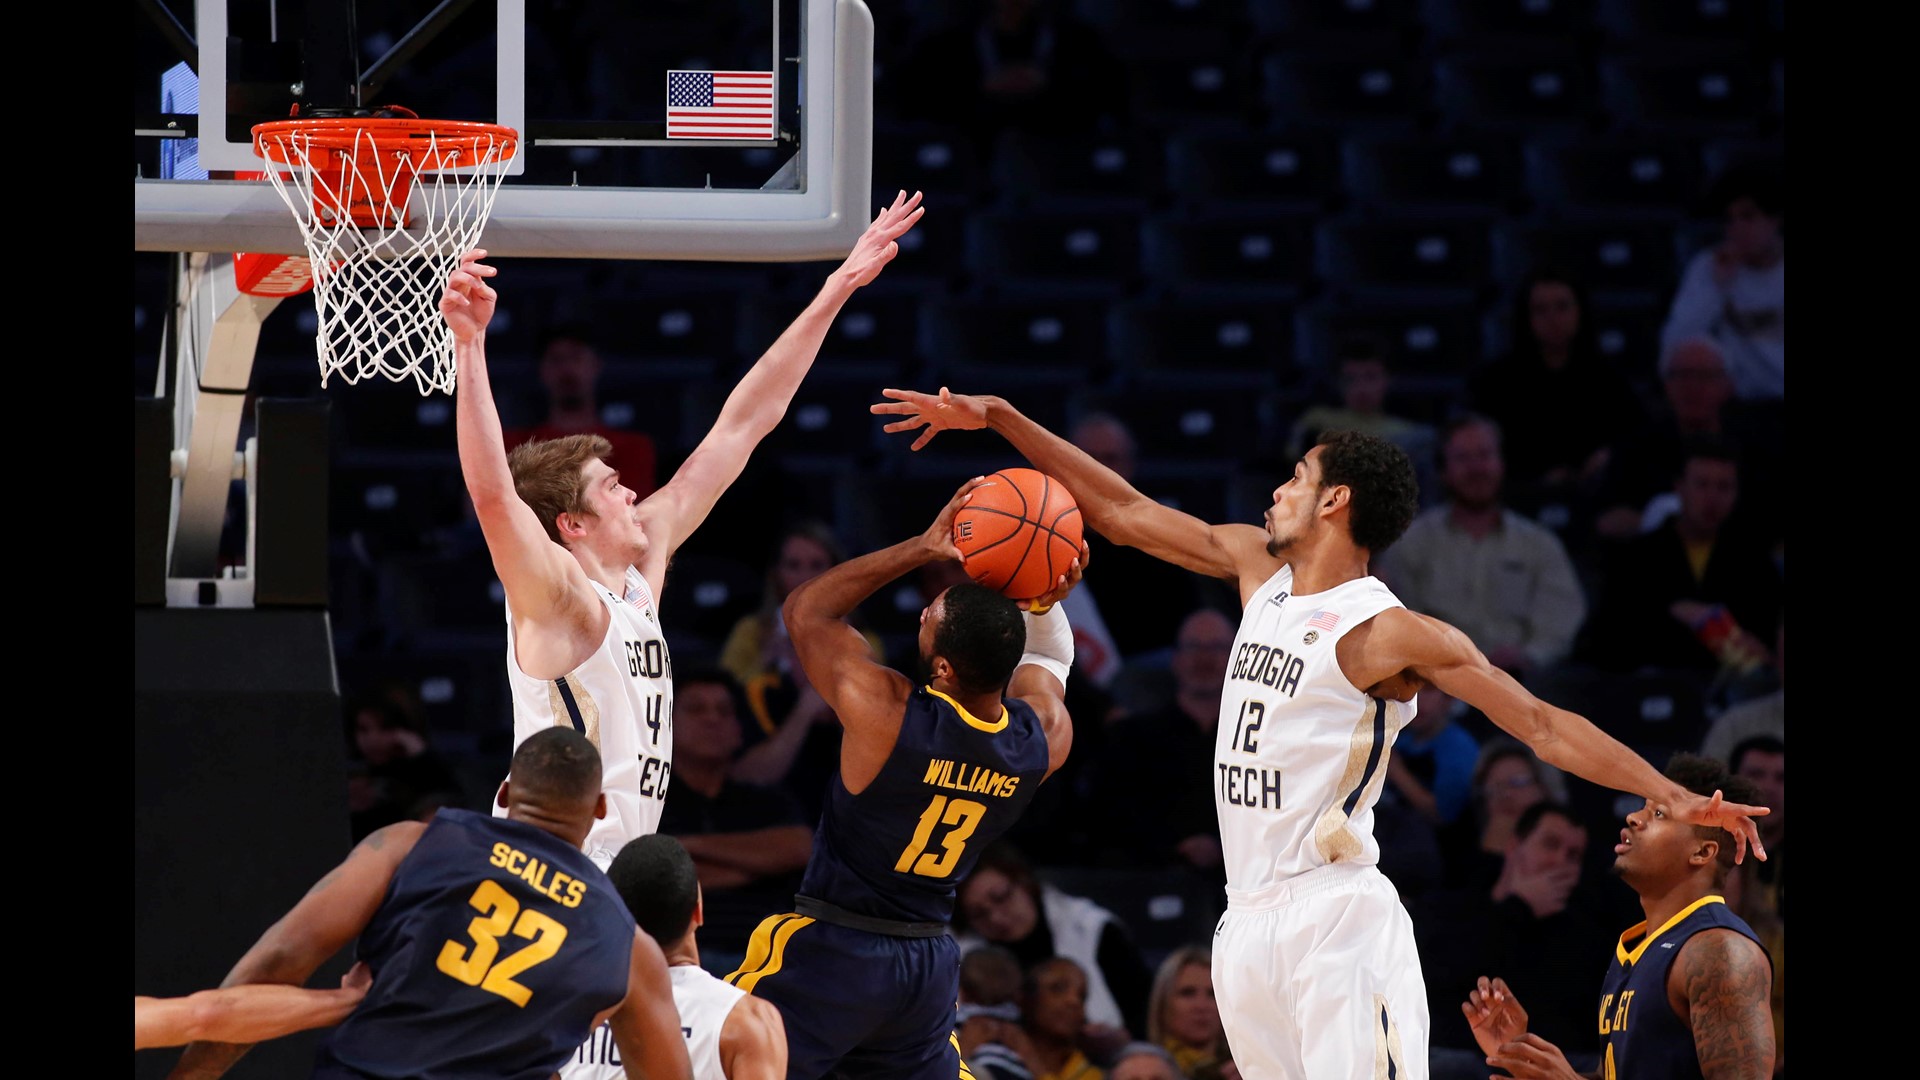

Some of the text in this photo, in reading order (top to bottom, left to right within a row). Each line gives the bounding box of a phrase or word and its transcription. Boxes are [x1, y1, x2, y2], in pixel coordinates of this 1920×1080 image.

[1231, 700, 1265, 754] 12
[923, 758, 1020, 798] WILLIAMS
[1218, 763, 1281, 810] TECH
[894, 794, 988, 879] 13
[489, 841, 588, 909] SCALES
[436, 879, 569, 1009] 32
